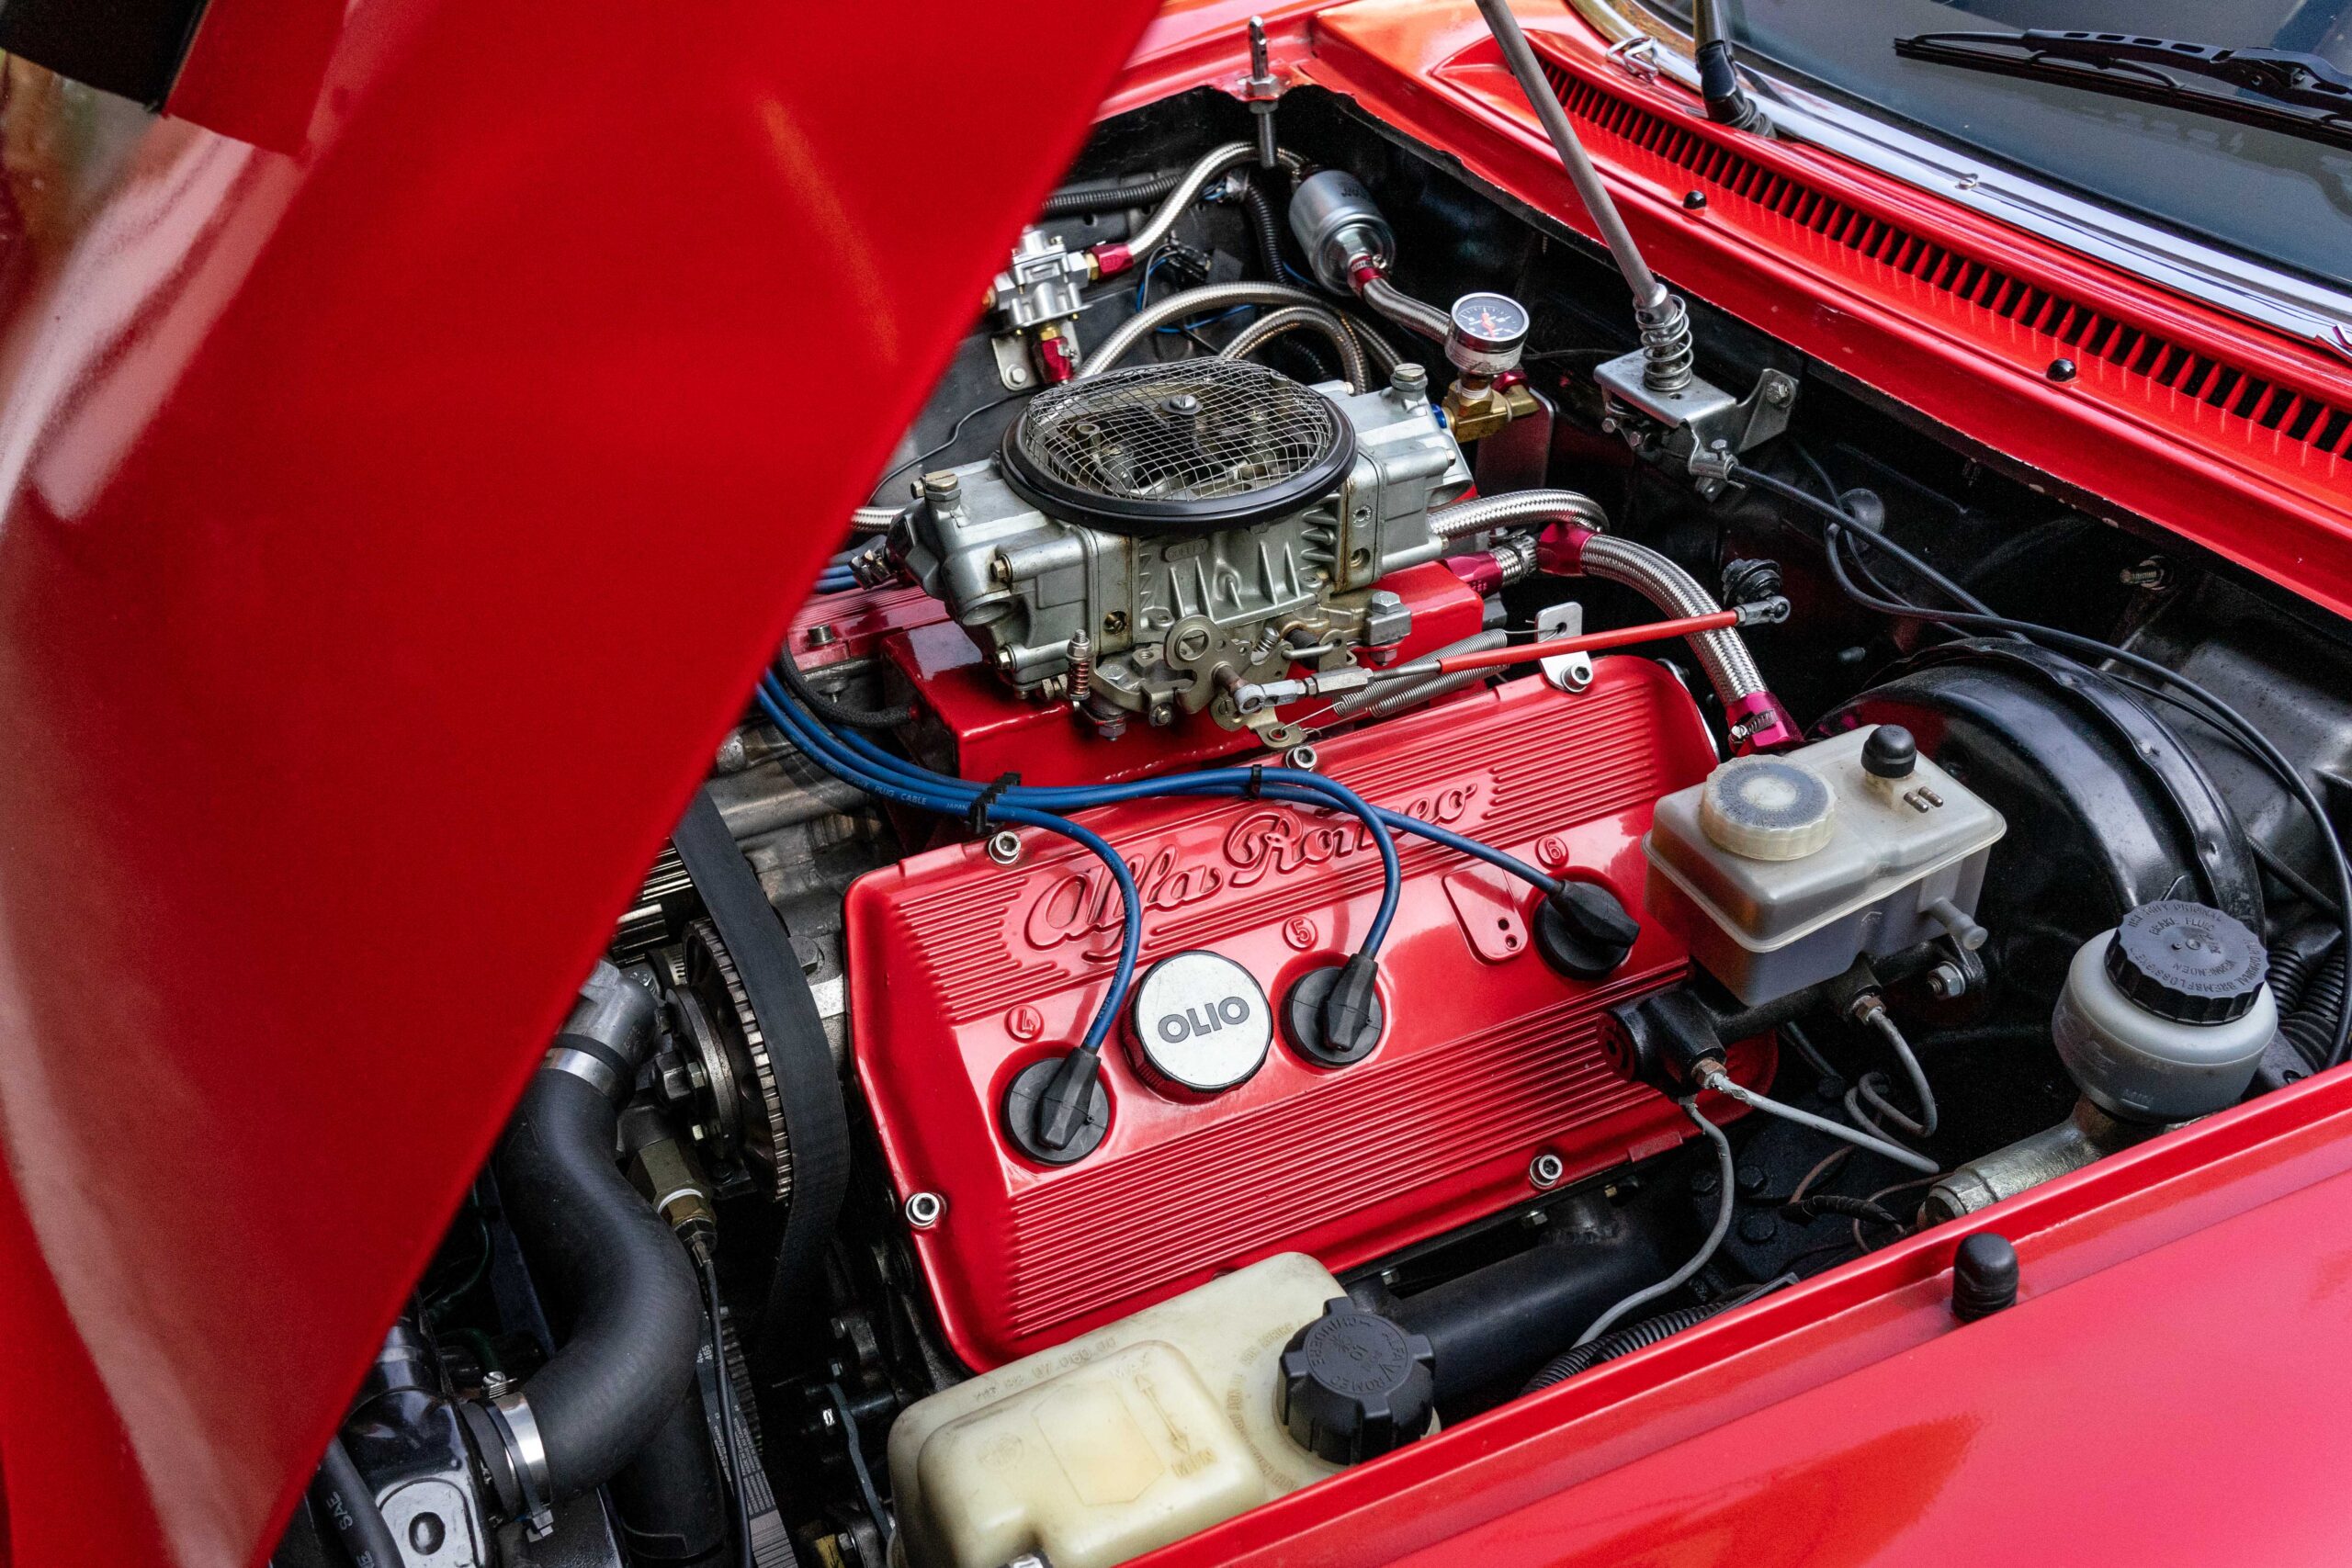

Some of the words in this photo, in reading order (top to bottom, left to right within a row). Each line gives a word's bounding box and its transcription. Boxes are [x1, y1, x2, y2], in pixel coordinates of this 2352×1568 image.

[875, 786, 895, 797] PLUG
[900, 794, 926, 806] CABLE
[1024, 843, 1225, 964] Alfa
[1158, 996, 1250, 1043] OLIO
[325, 1491, 353, 1530] SAE
